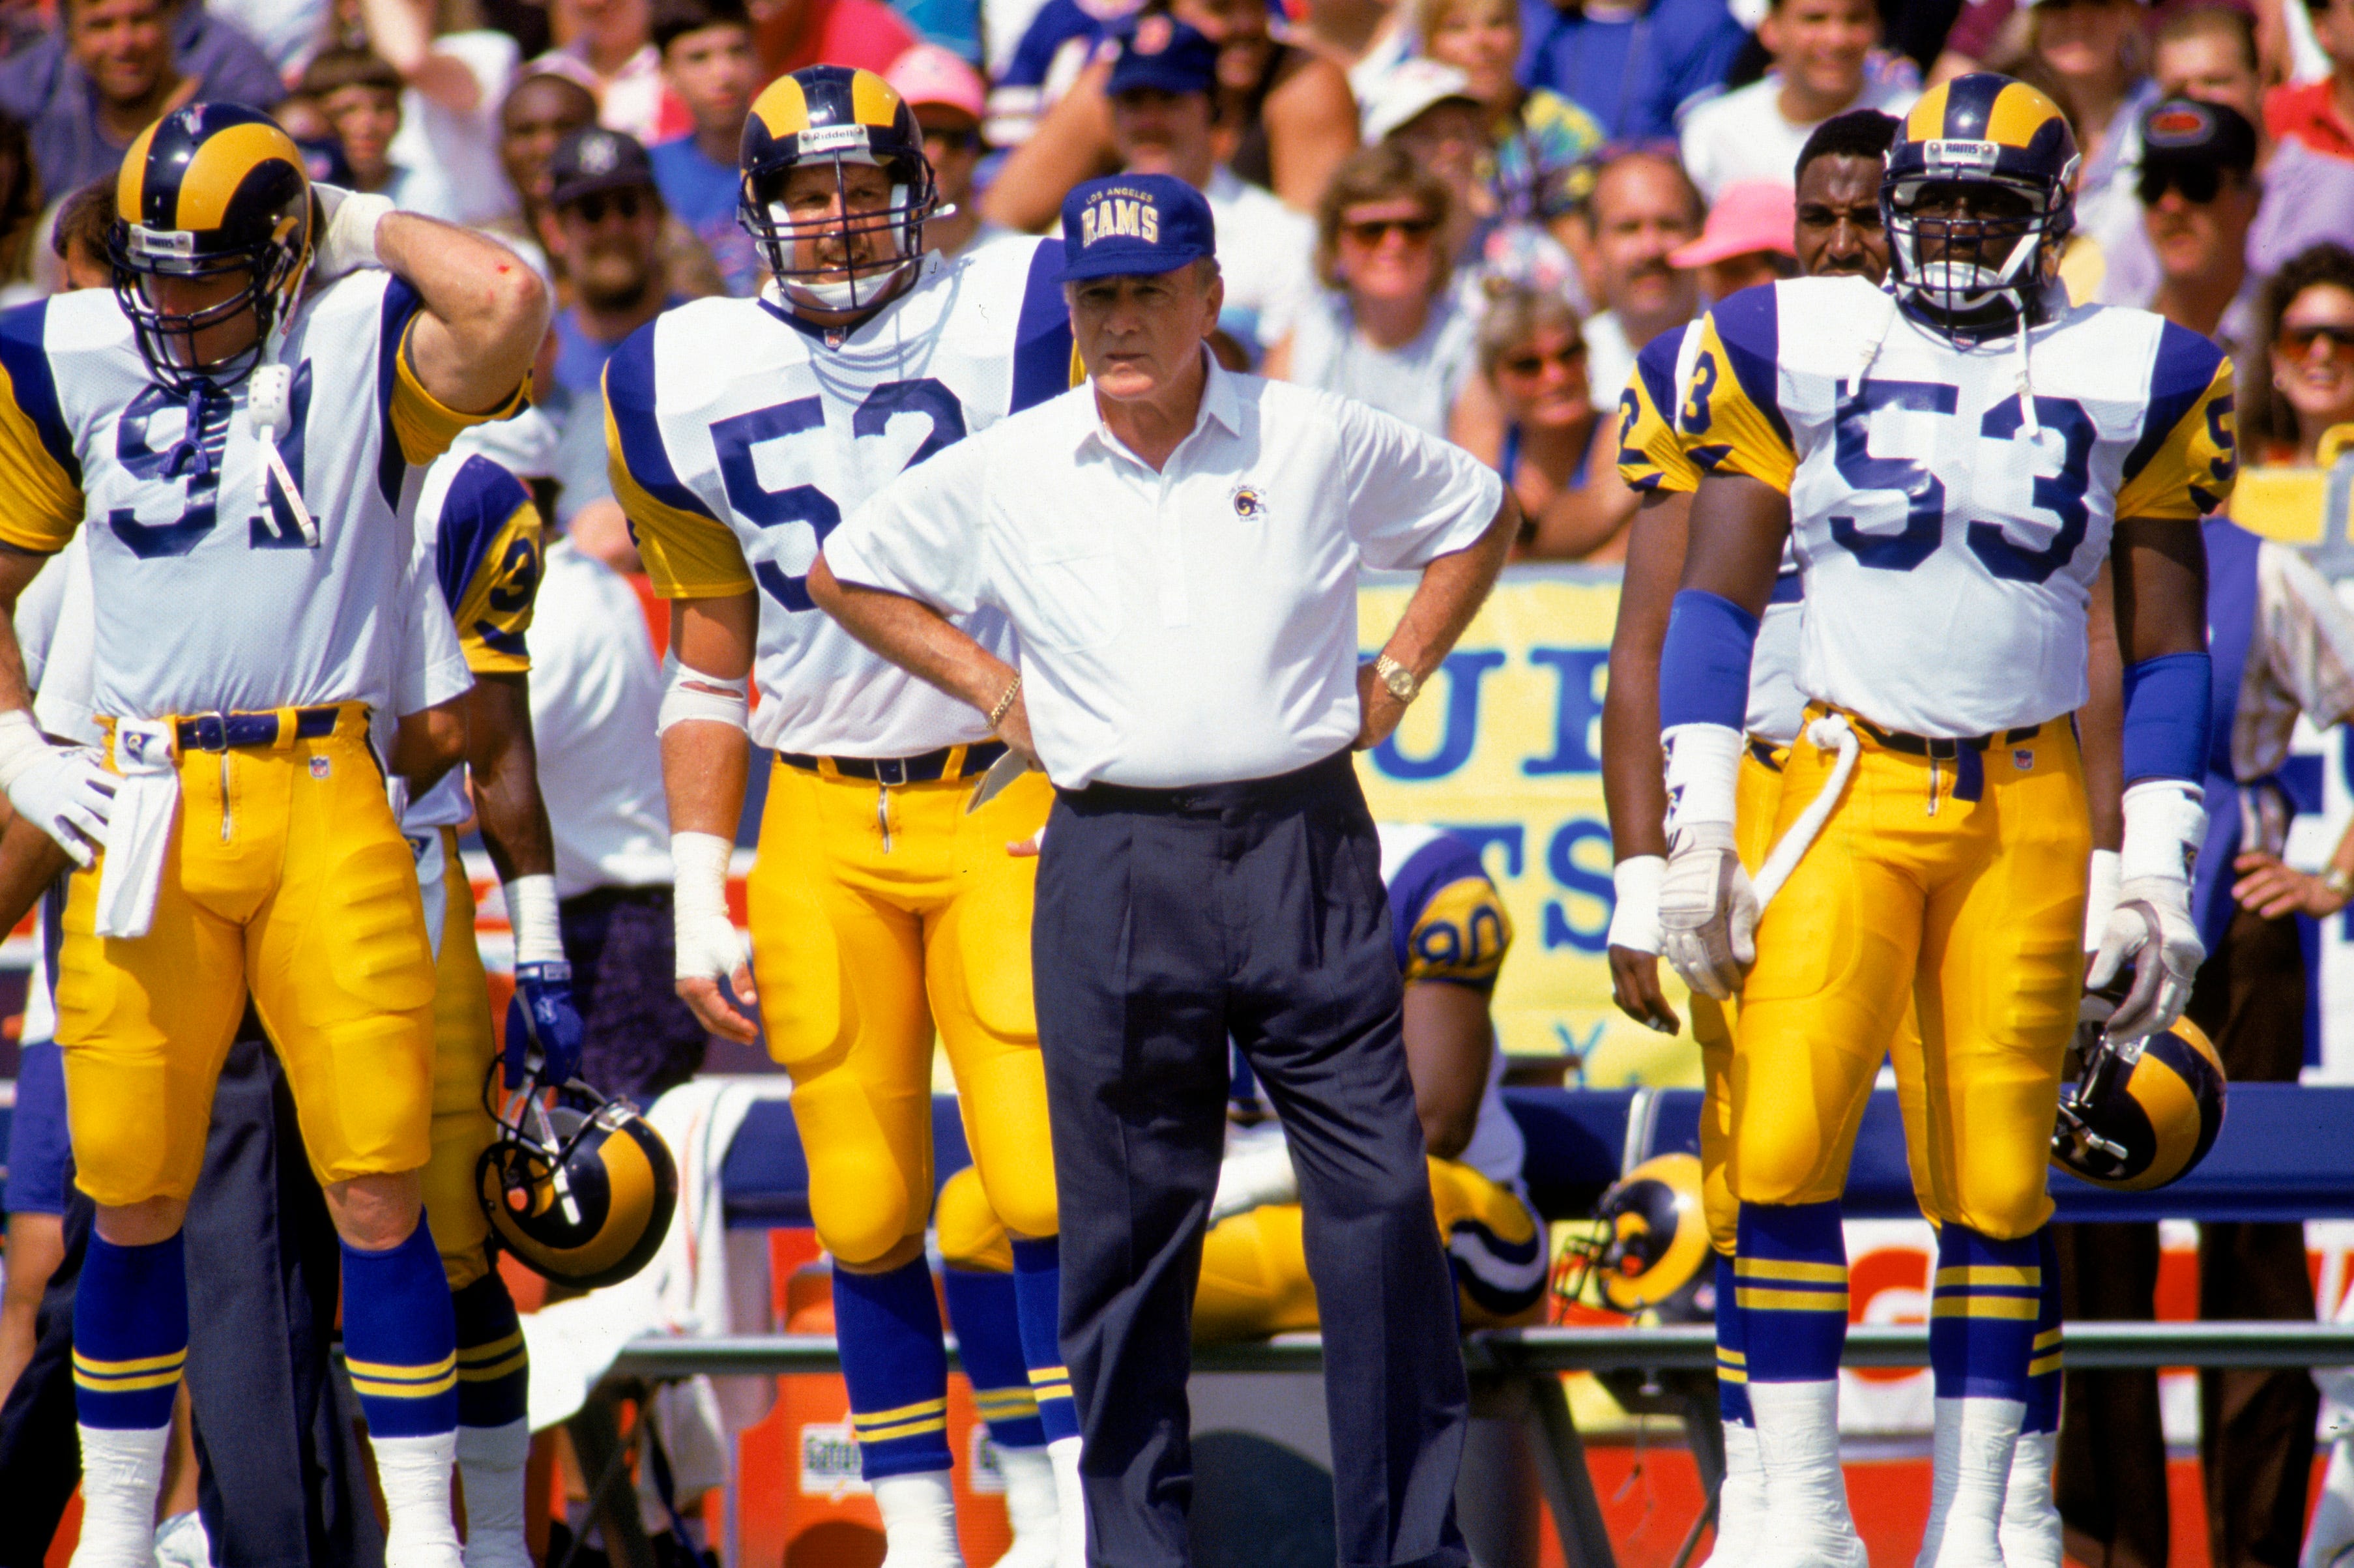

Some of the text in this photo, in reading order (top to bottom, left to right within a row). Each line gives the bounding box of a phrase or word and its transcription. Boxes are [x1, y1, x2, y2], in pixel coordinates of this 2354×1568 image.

[813, 130, 852, 140] Riddell
[1086, 188, 1154, 205] LOS ANGELES
[1082, 199, 1158, 248] RAMS
[1829, 378, 2097, 585] 53
[490, 537, 538, 613] 3
